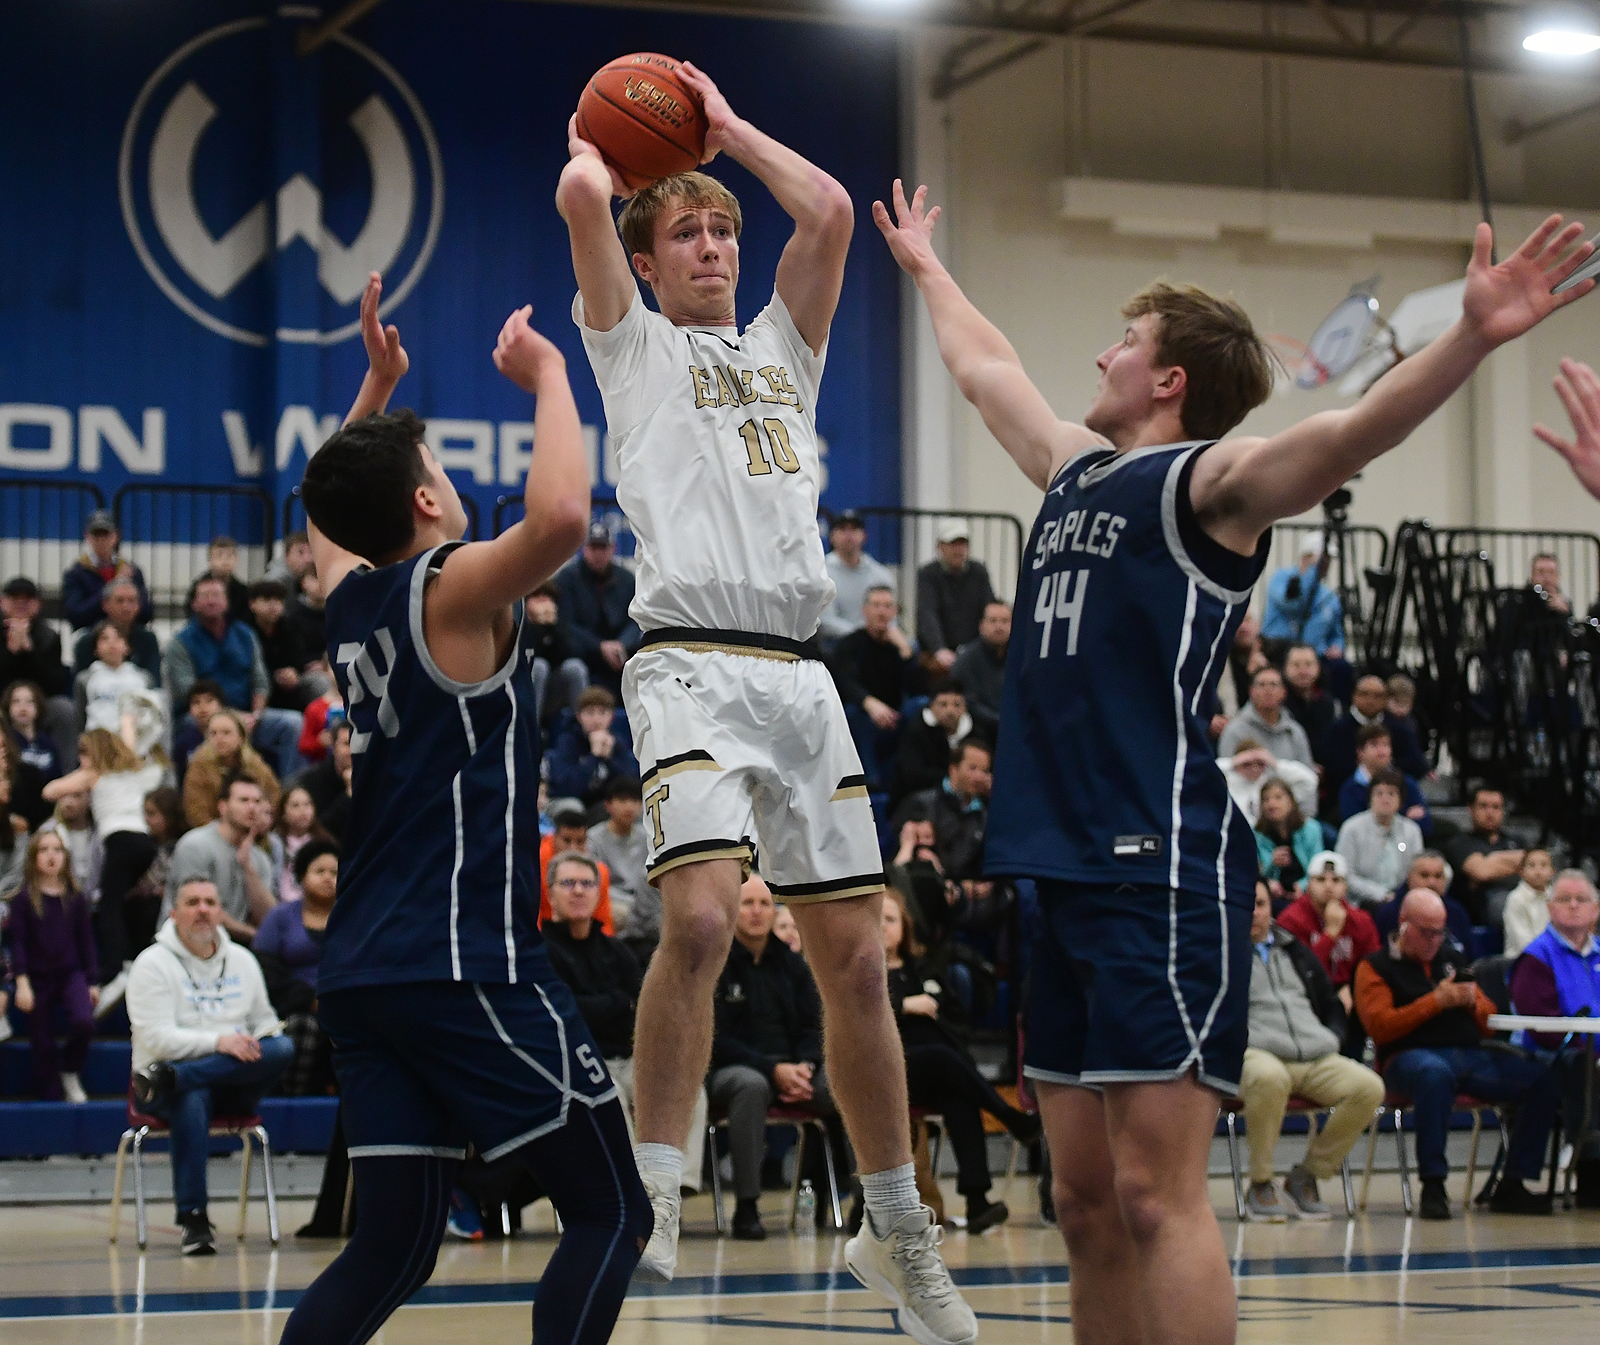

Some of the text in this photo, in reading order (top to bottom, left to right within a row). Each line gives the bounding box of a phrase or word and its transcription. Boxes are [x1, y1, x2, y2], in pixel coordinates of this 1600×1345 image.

[738, 418, 800, 476] 10
[1032, 509, 1128, 570] SAPLES
[1034, 569, 1090, 659] 44
[645, 784, 670, 852] T
[575, 1043, 605, 1085] S
